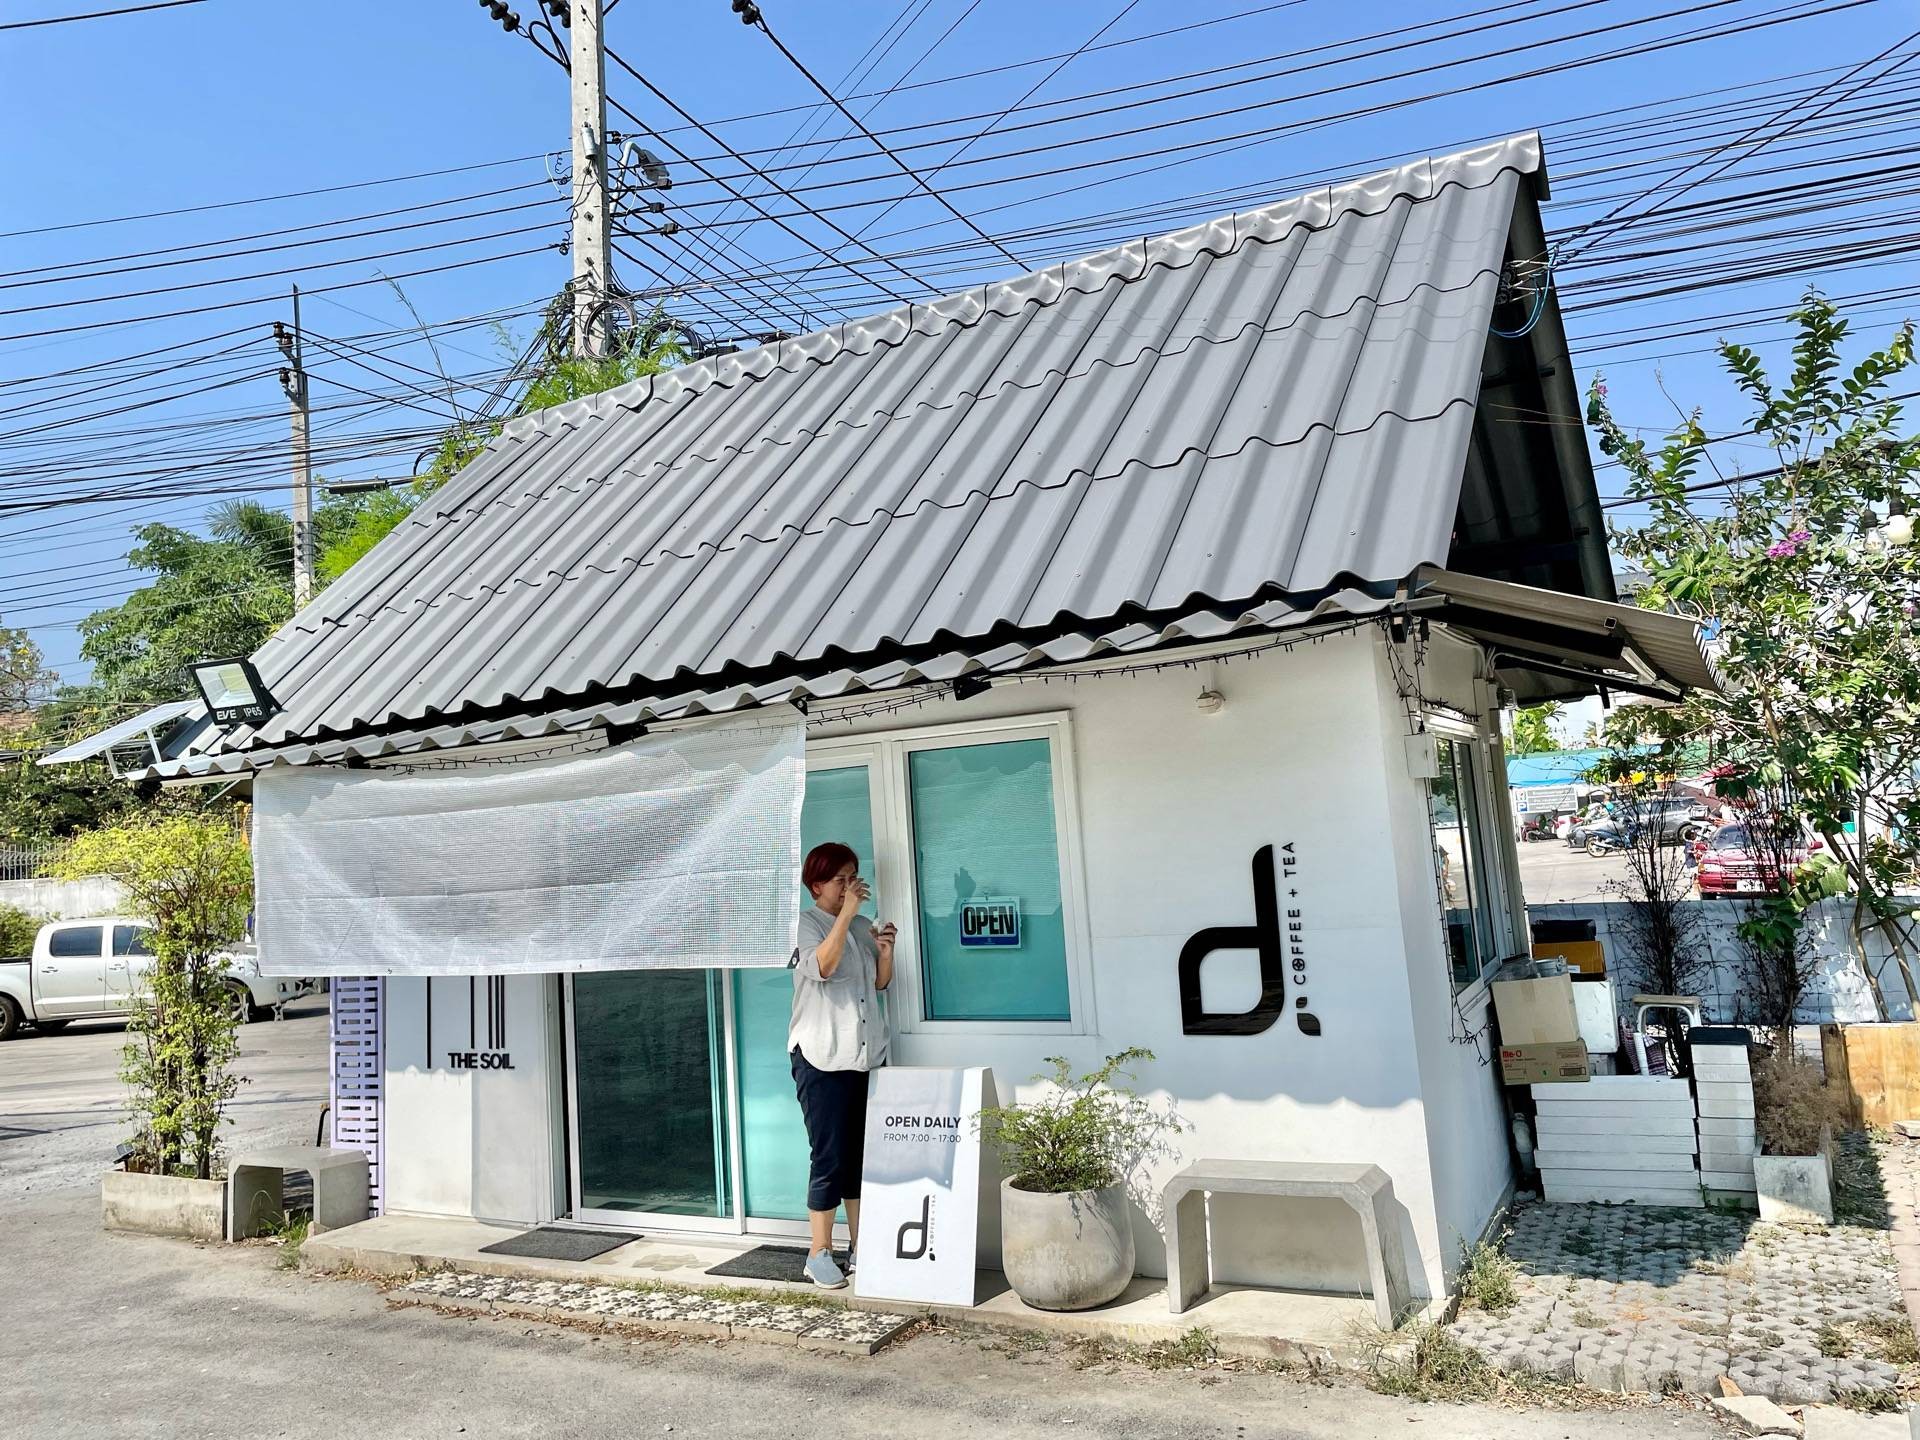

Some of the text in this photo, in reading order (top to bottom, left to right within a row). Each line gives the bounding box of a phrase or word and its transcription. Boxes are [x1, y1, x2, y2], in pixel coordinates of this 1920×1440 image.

[216, 706, 263, 720] EVE IP65
[1282, 842, 1297, 878] TEA
[963, 906, 1014, 935] OPEN
[1287, 908, 1306, 985] COFFEE
[448, 1052, 515, 1070] THE SOIL
[885, 1115, 961, 1129] OPEN DAILY
[883, 1133, 908, 1142] FROM
[911, 1133, 930, 1142] 7:00
[939, 1134, 962, 1143] 17:00
